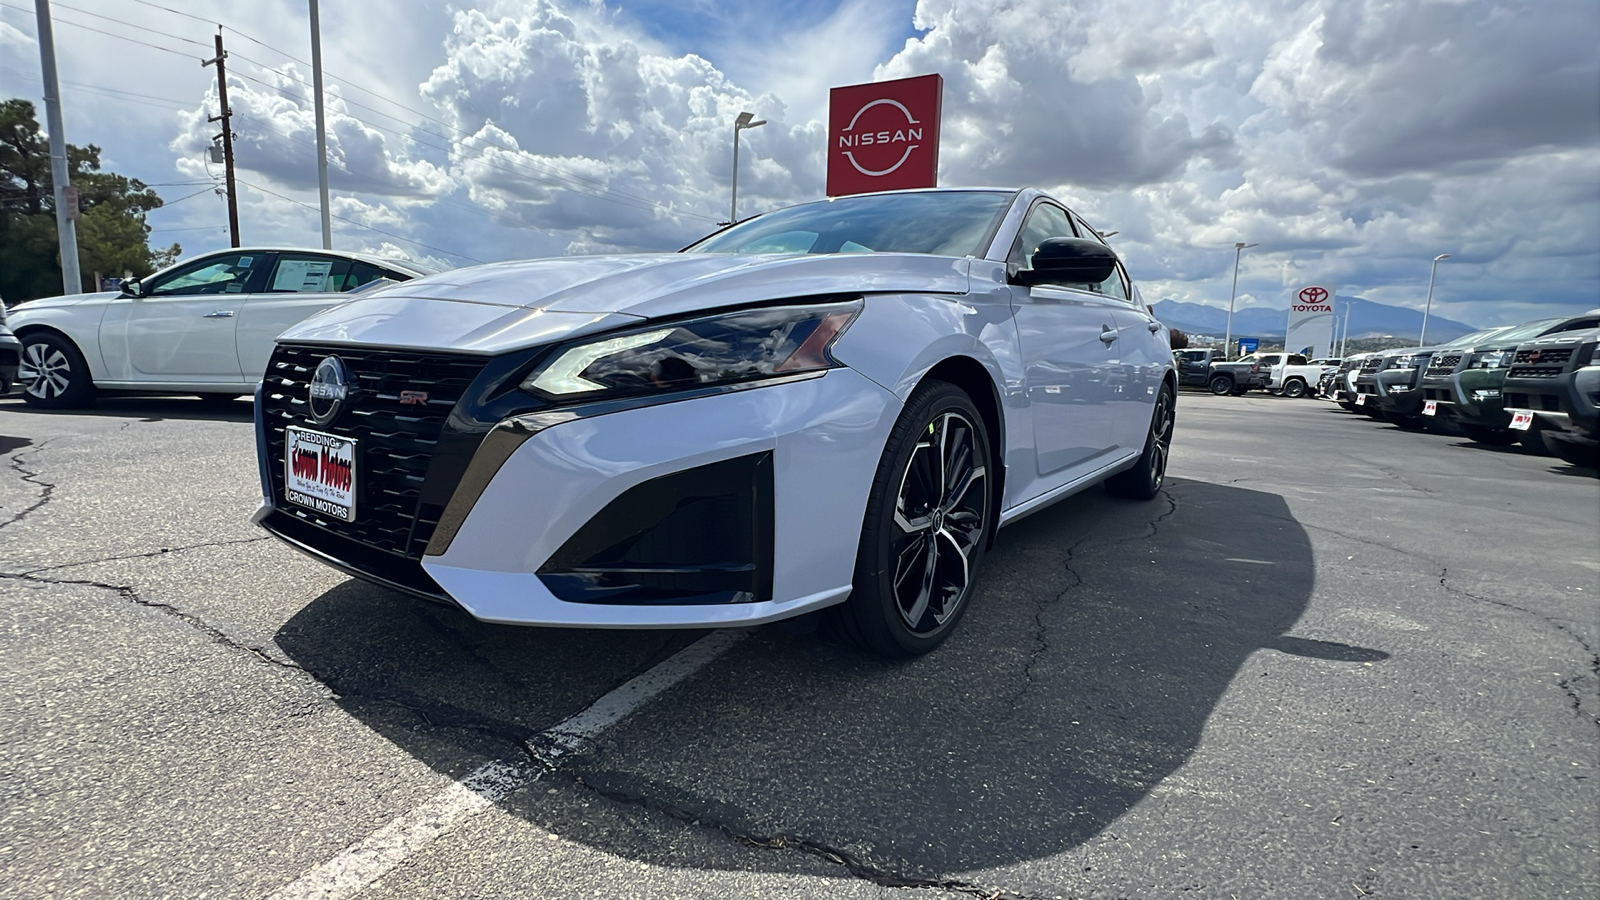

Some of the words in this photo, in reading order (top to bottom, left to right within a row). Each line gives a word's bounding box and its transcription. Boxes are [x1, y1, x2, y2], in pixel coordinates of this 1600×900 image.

[839, 128, 922, 148] NISSAN
[1292, 304, 1332, 312] TOYOTA
[311, 383, 346, 398] SSAN
[400, 390, 427, 405] SR
[300, 432, 336, 447] REDDING
[292, 446, 318, 482] Crown
[320, 445, 352, 492] Motors
[289, 491, 314, 508] CROWN
[316, 499, 347, 518] MOTORS
